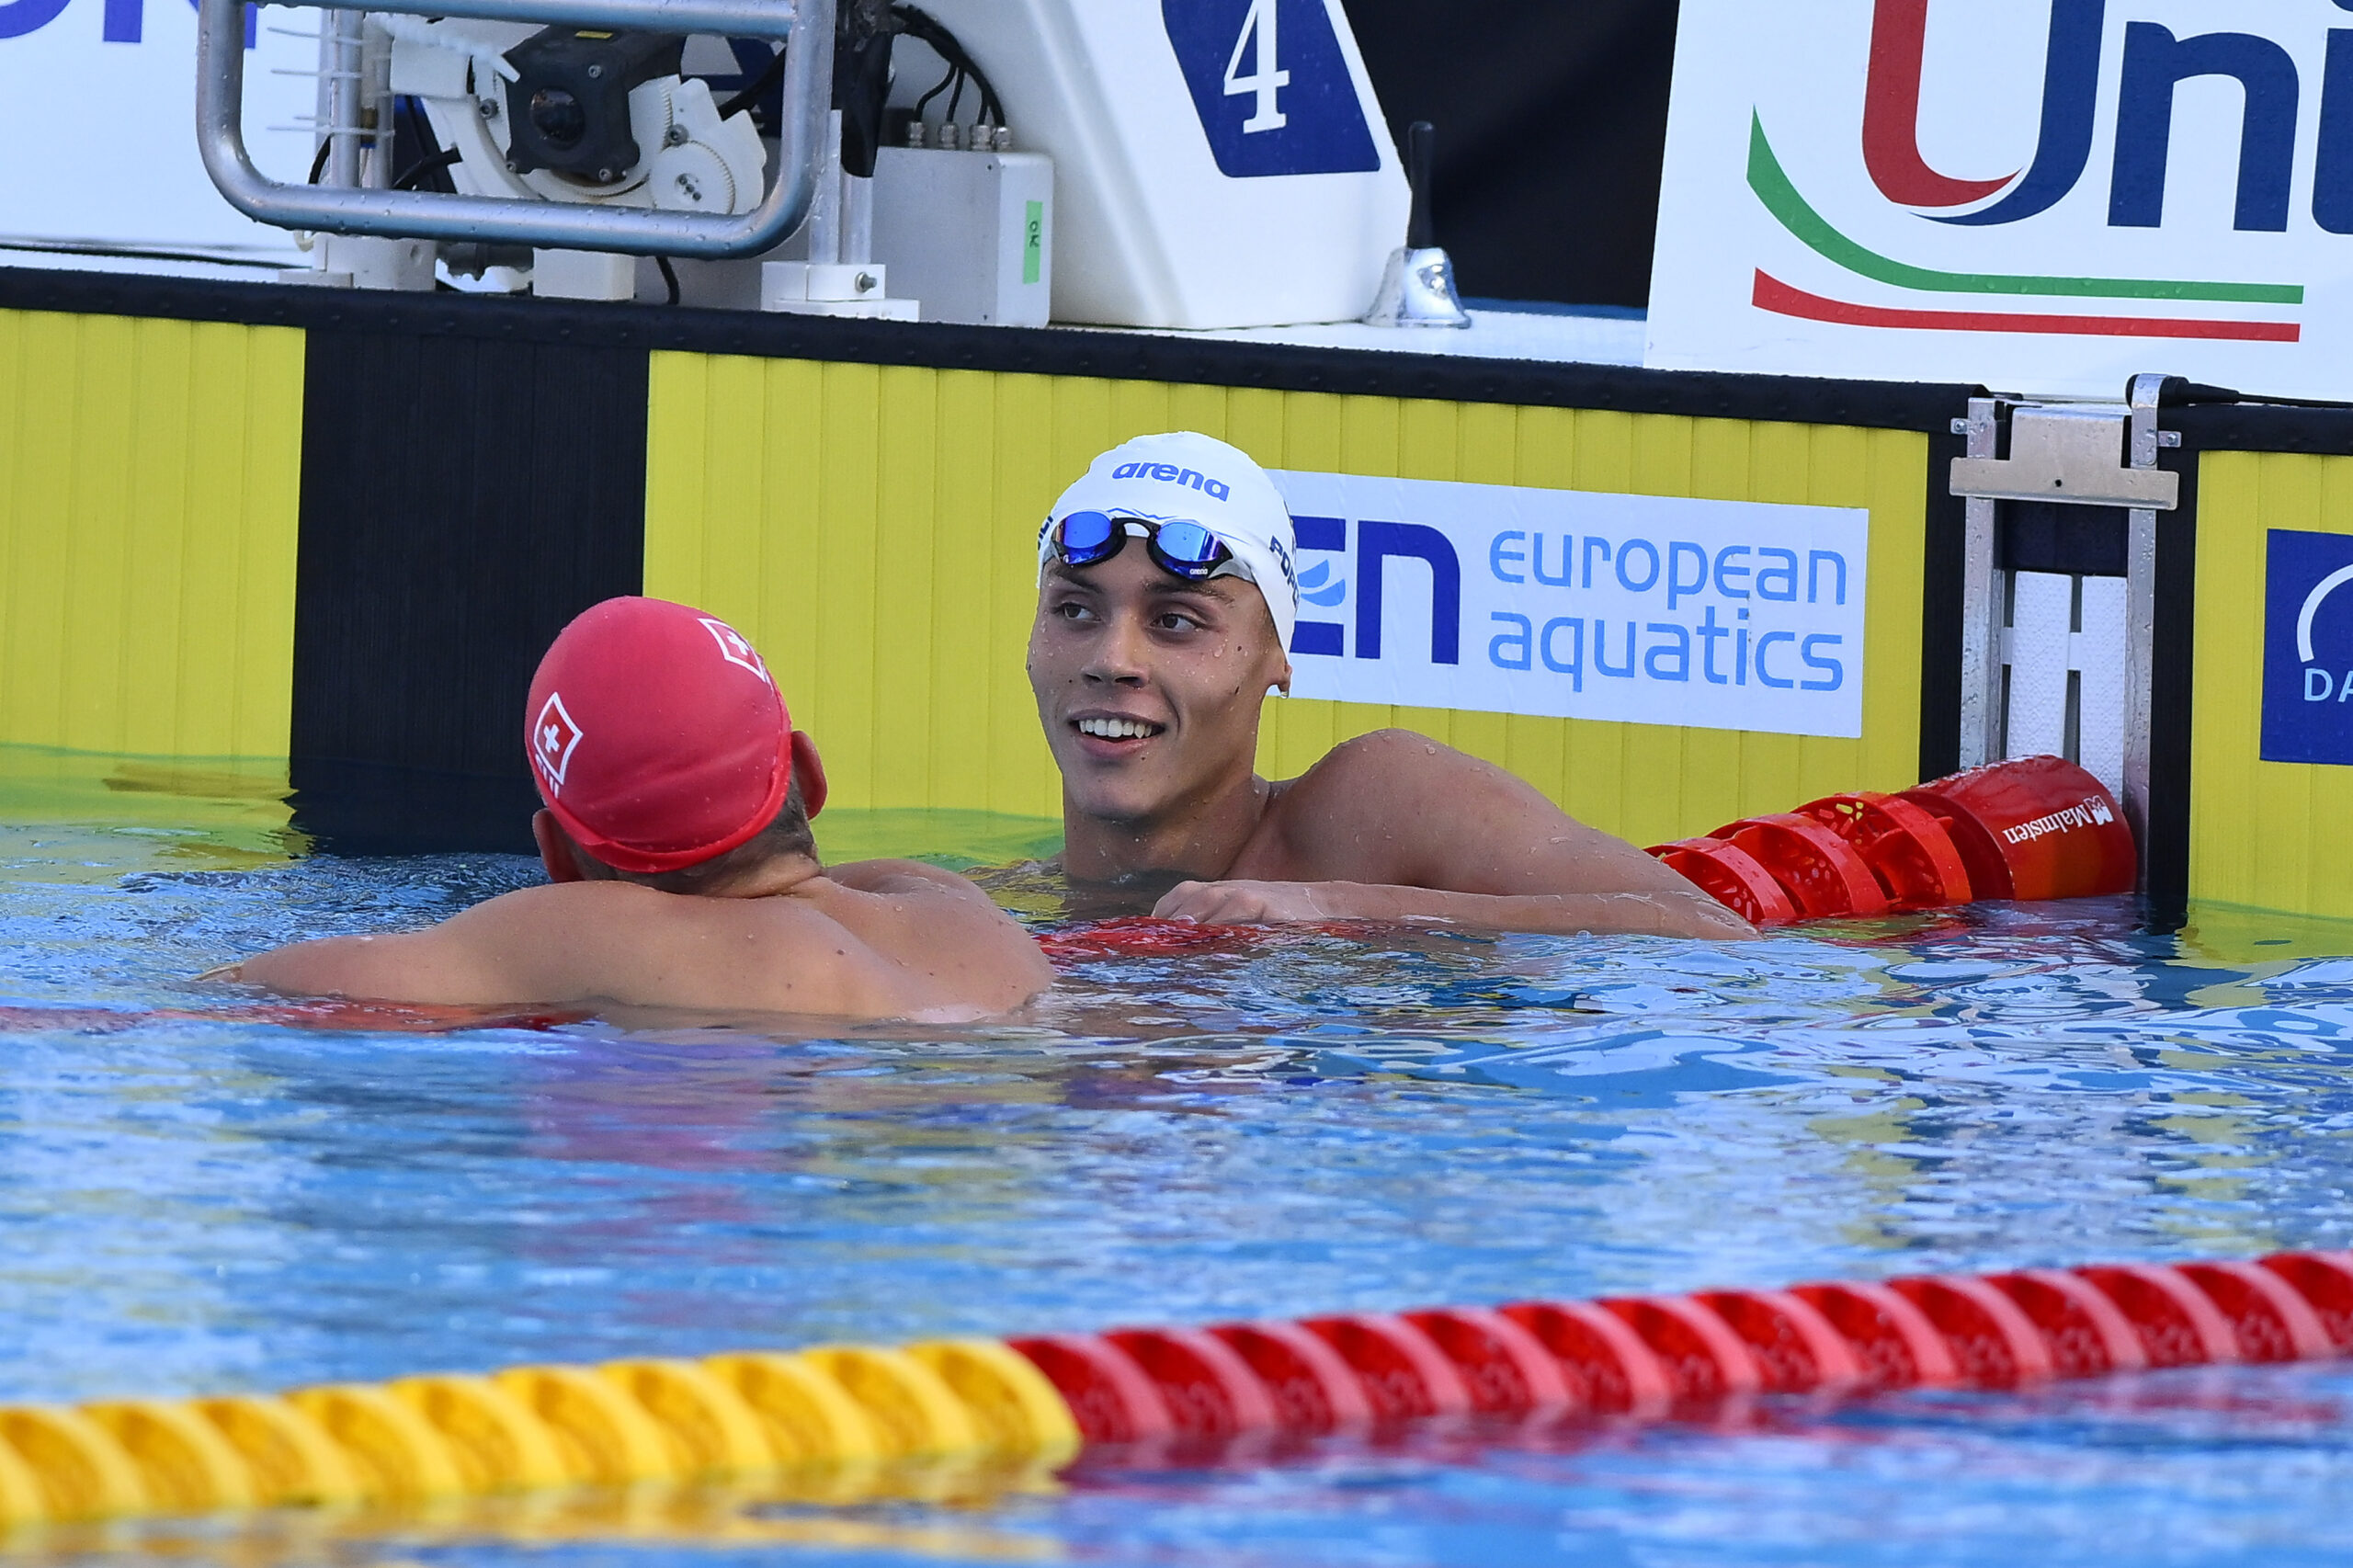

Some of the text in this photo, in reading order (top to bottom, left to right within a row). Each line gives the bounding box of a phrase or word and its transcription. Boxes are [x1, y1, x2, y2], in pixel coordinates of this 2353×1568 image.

[1223, 0, 1290, 134] 4
[1112, 461, 1231, 502] arena
[1489, 529, 1847, 610] european
[1488, 606, 1844, 692] aquatics
[2002, 803, 2093, 845] Malmsten
